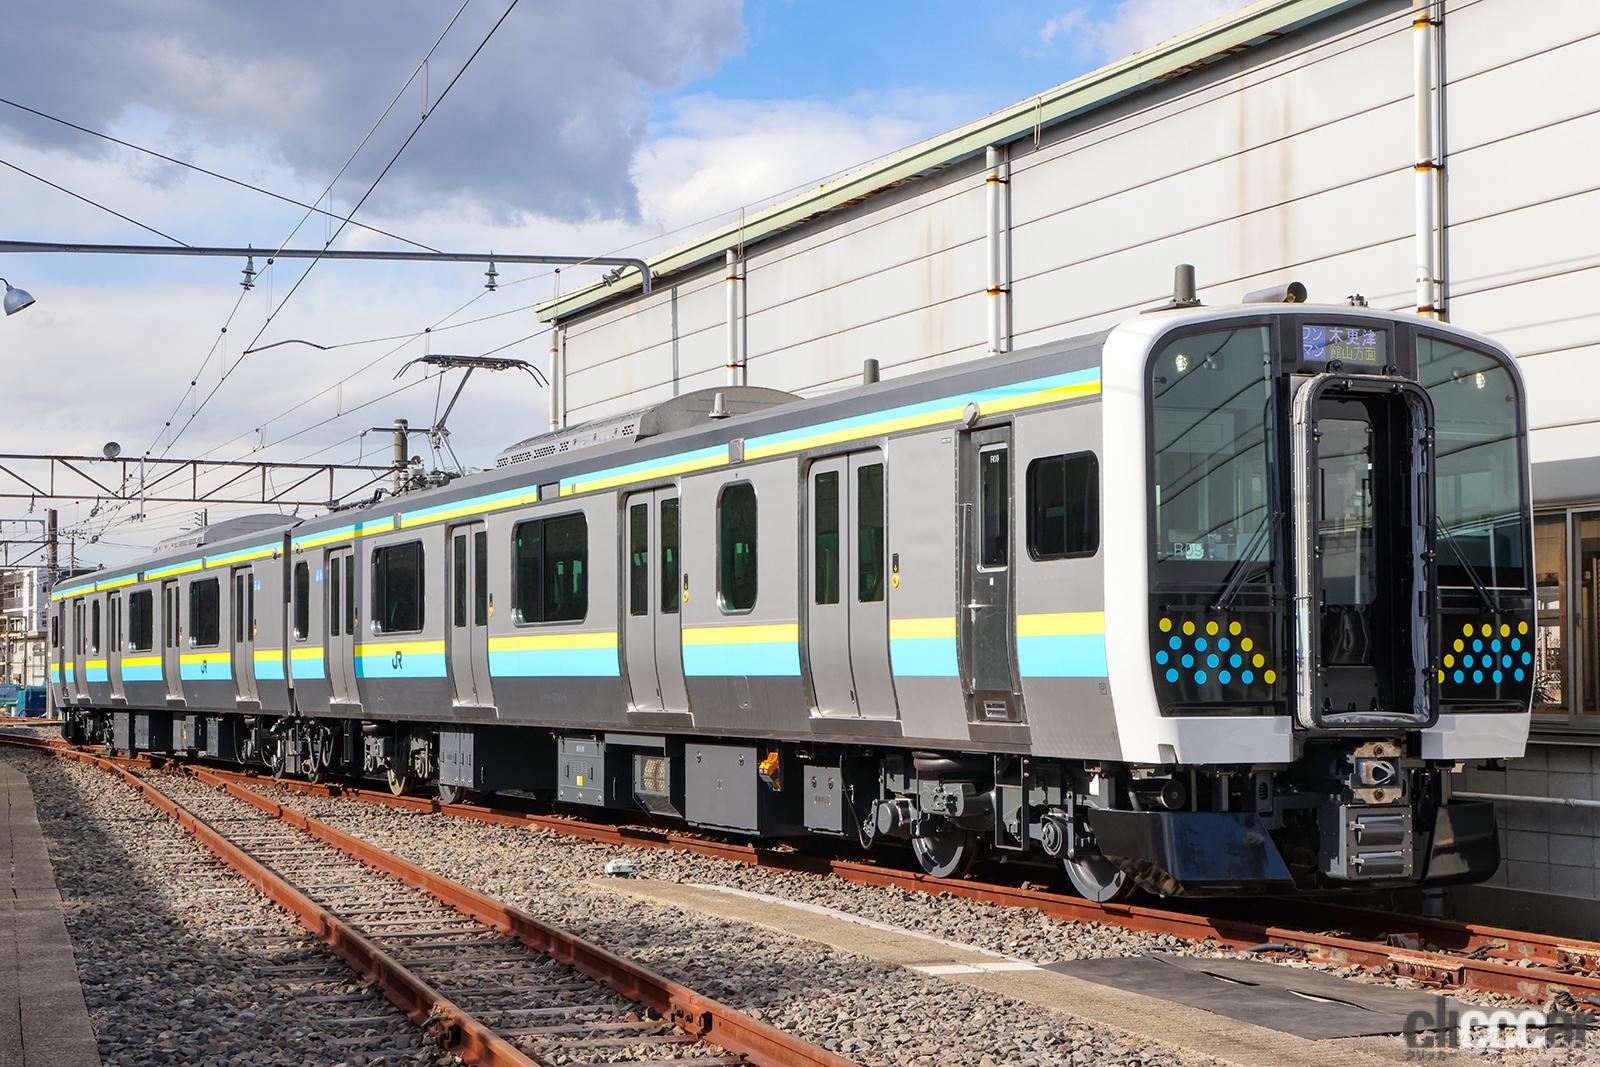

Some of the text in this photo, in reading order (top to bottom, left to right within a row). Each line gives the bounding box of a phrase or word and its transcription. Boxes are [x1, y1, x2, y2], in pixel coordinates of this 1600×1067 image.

[1303, 327, 1322, 341] ワン
[1329, 327, 1377, 346] 木更津
[1303, 344, 1324, 357] マン
[1330, 344, 1377, 361] 館山方面
[201, 660, 208, 674] JR
[392, 651, 403, 669] JR
